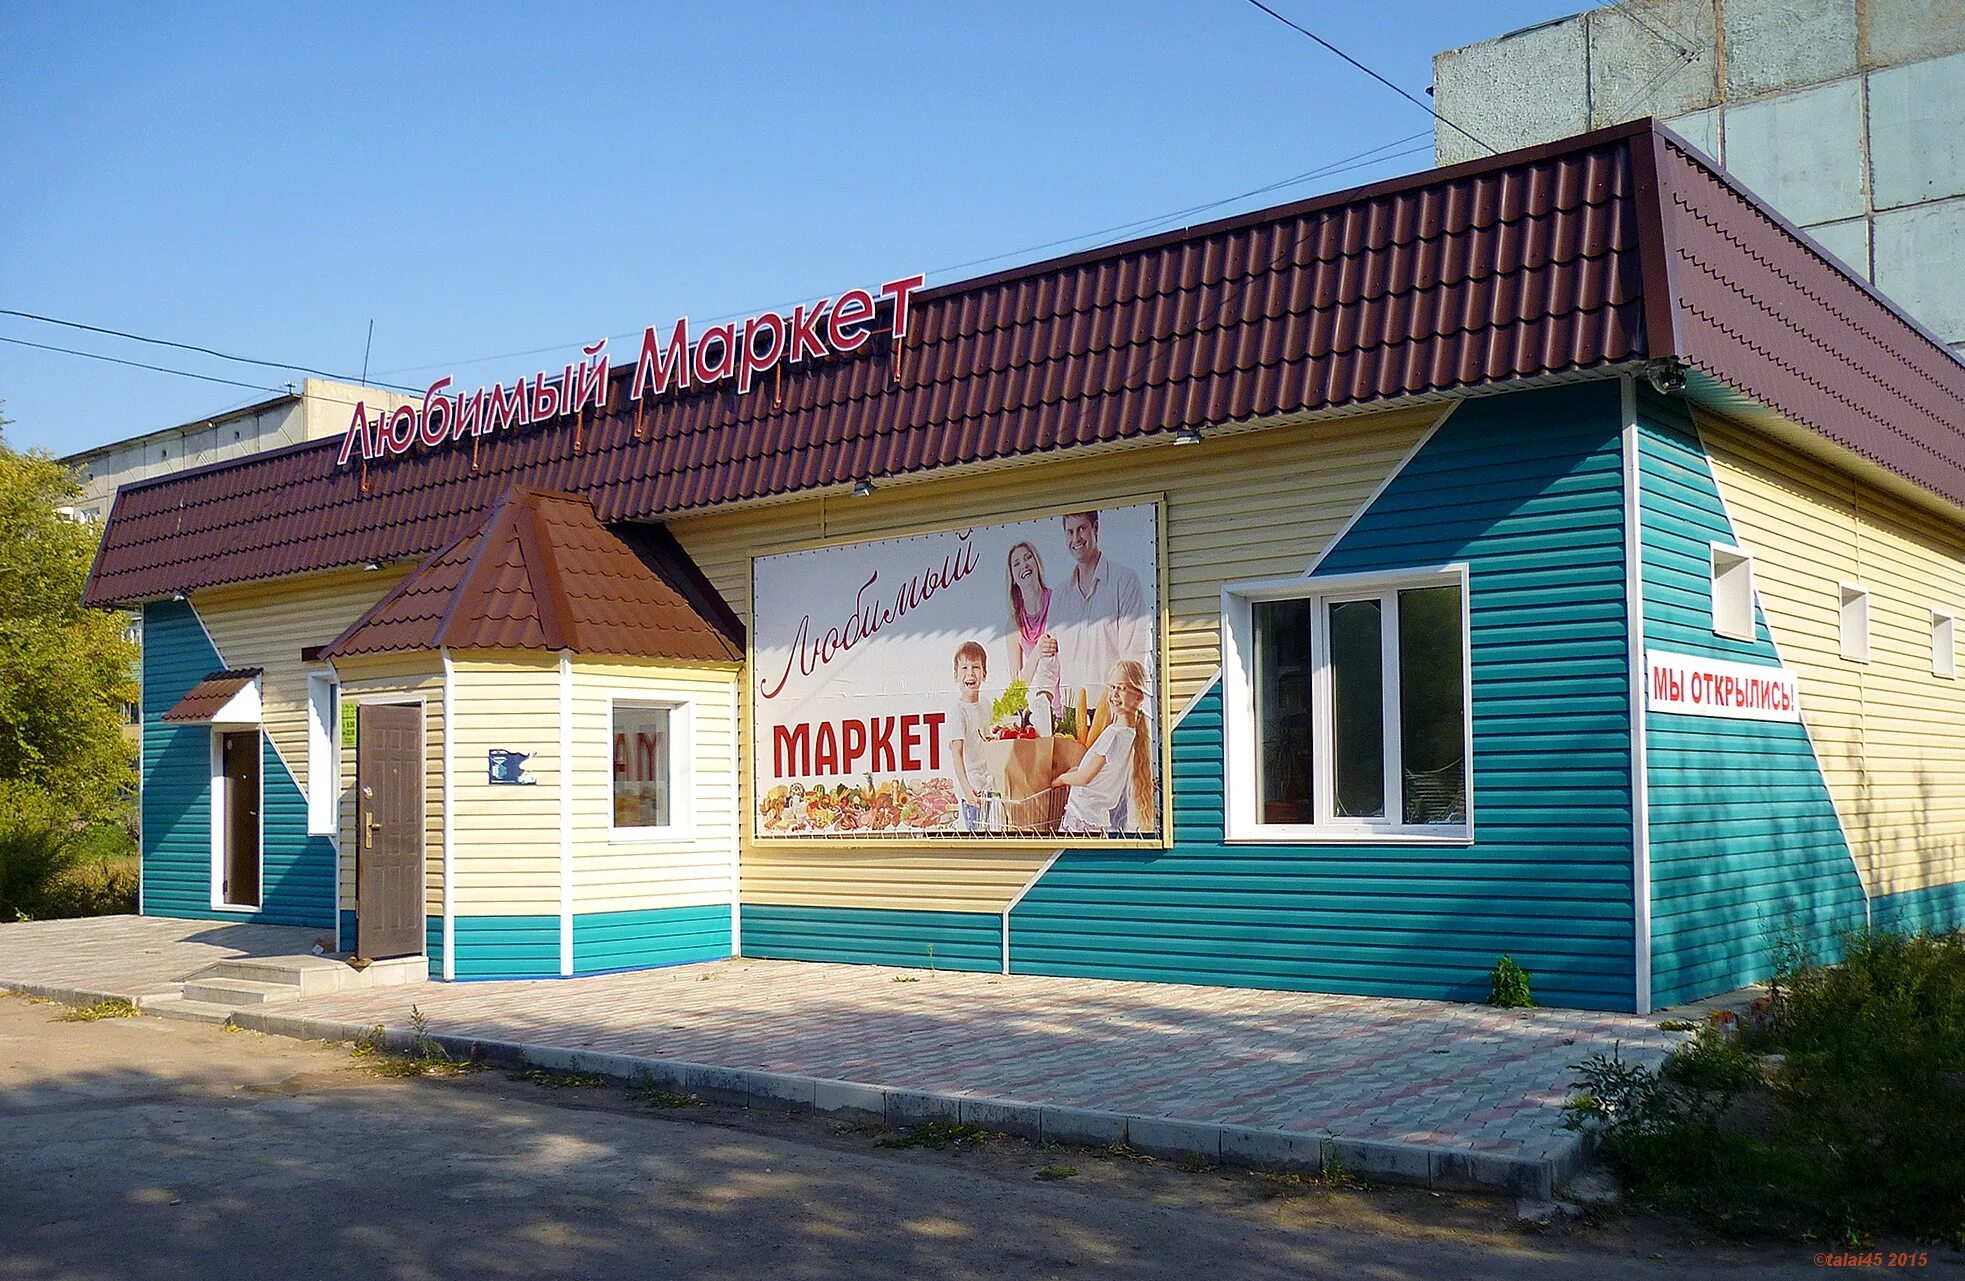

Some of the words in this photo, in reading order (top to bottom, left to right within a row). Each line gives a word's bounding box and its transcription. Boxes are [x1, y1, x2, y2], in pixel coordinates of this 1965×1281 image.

[337, 337, 610, 465] Любимый
[631, 271, 927, 401] Маркет
[760, 527, 980, 699] Любимый
[773, 712, 946, 778] МАРКЕТ
[1653, 666, 1685, 703] МЫ
[1691, 671, 1795, 712] ОТКРЫЛИСЬ!
